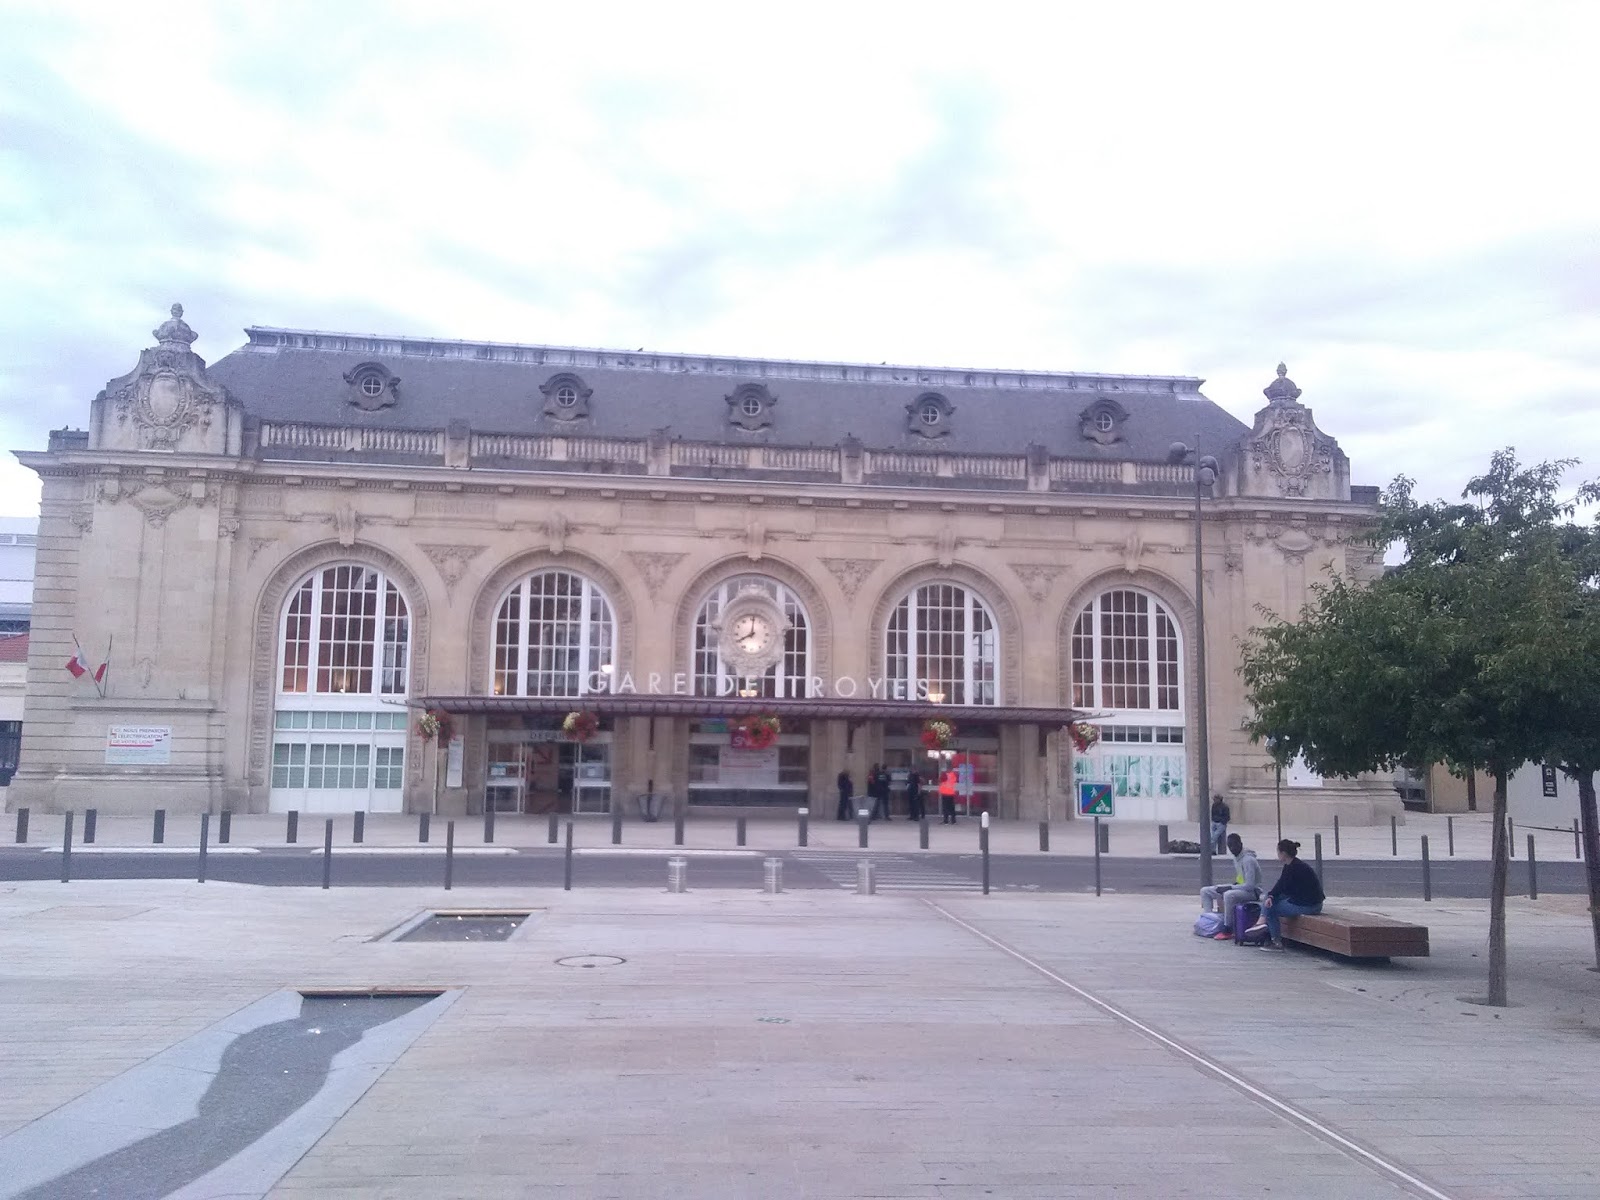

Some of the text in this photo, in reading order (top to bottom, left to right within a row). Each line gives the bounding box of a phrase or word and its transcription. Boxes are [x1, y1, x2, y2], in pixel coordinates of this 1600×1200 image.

[588, 671, 928, 700] GARE DE TROYES
